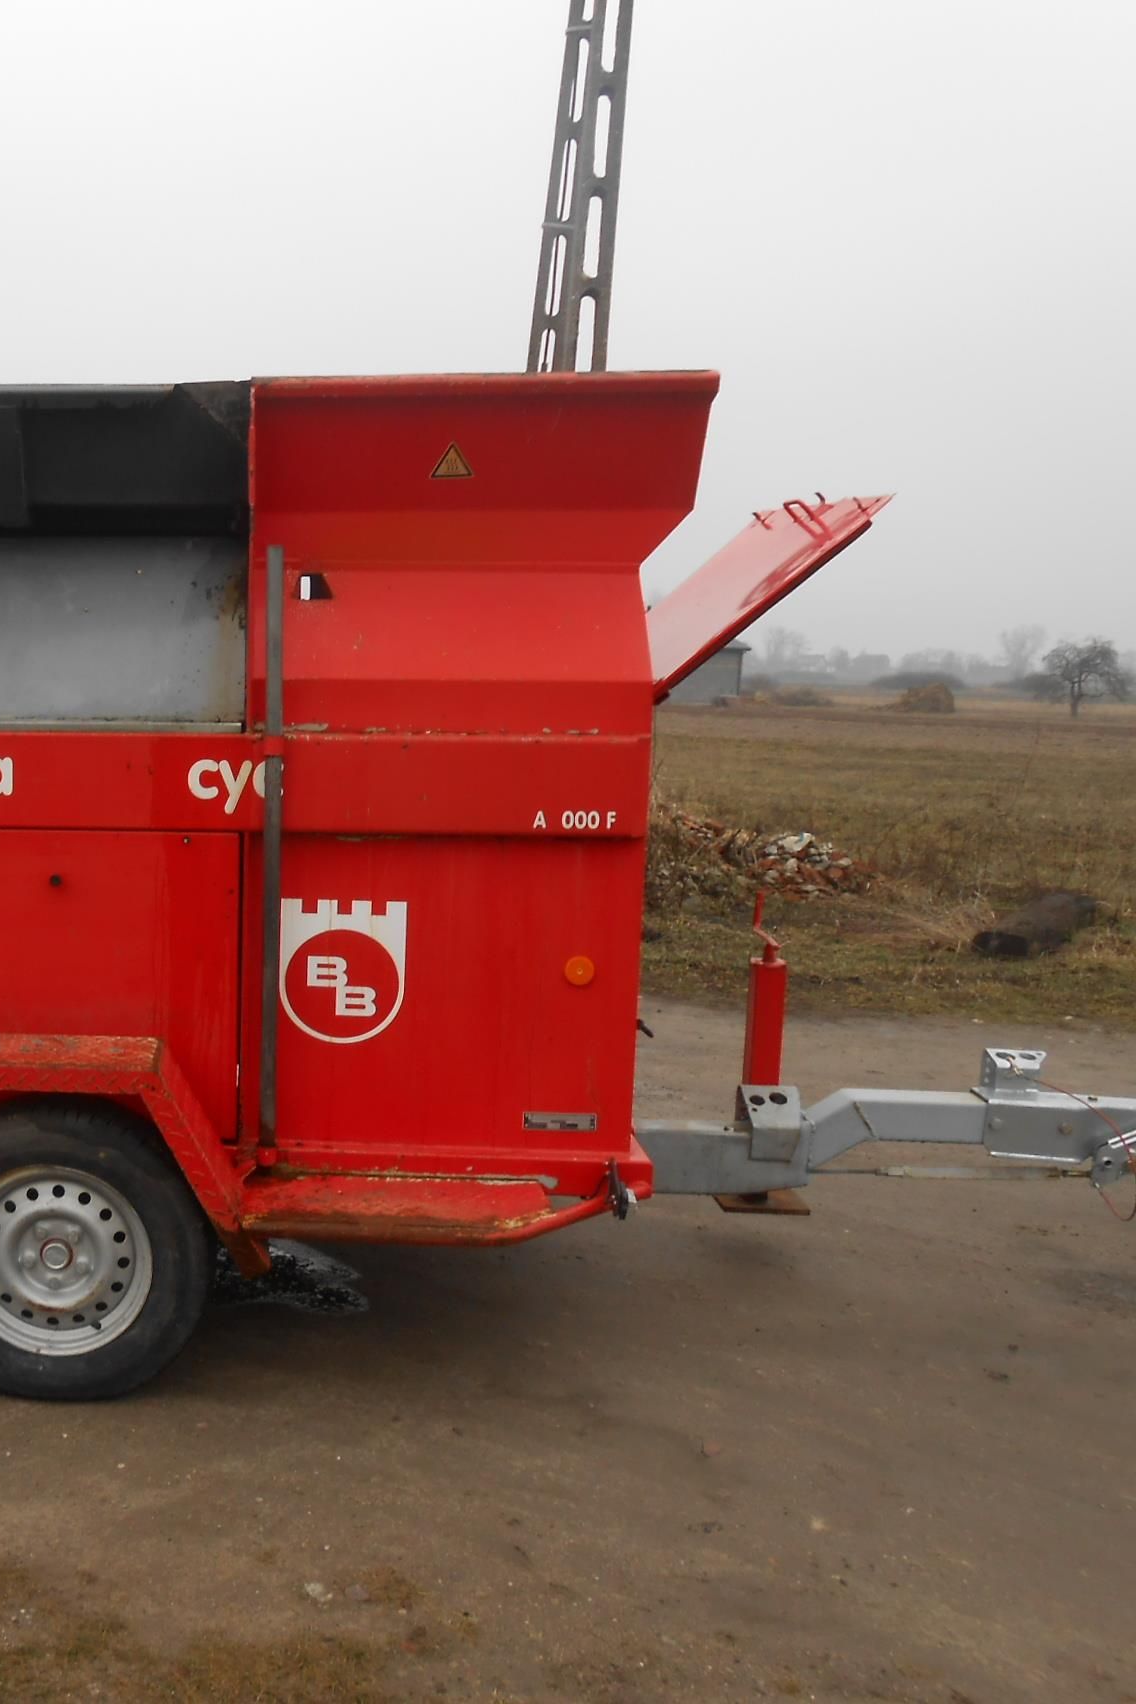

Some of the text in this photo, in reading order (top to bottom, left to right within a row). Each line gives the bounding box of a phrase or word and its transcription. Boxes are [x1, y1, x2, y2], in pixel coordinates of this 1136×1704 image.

[532, 810, 617, 830] A 000 F
